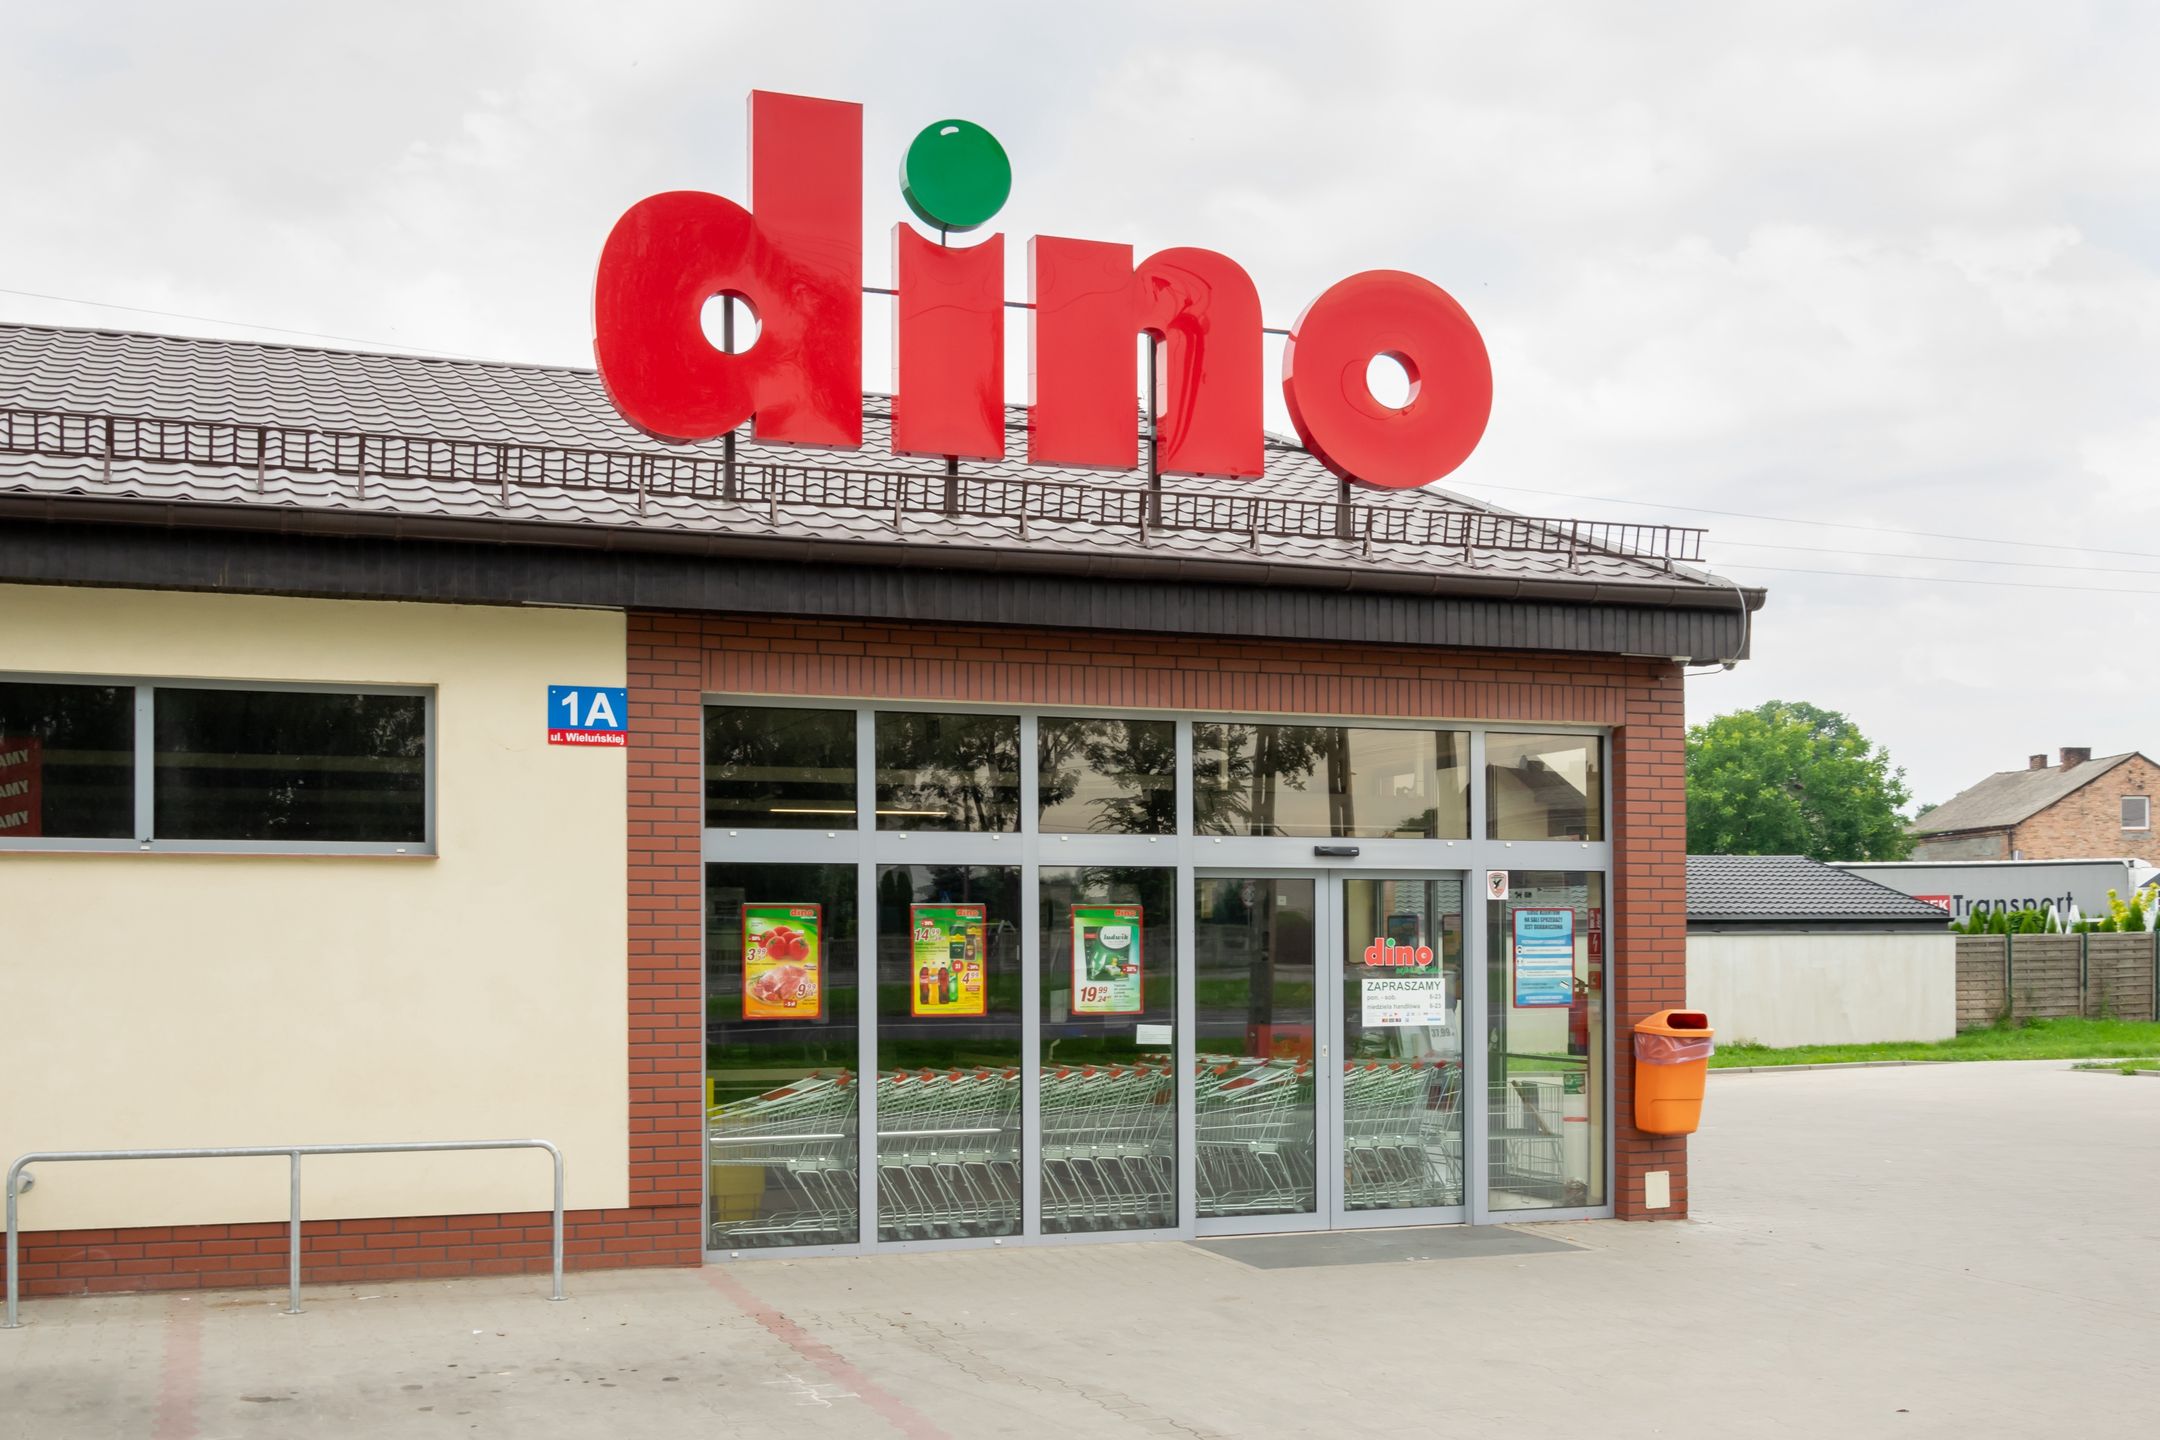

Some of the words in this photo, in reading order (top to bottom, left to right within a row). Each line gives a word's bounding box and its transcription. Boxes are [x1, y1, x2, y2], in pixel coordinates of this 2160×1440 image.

[591, 89, 1494, 490] dino
[561, 691, 618, 727] 1A
[550, 732, 563, 742] ul.
[566, 733, 625, 746] Wieluńskiej
[1953, 892, 2073, 916] Transport
[915, 929, 929, 940] 14
[1365, 938, 1433, 966] dino
[1081, 987, 1097, 1002] 19
[1367, 982, 1441, 991] ZAPRASZAMY
